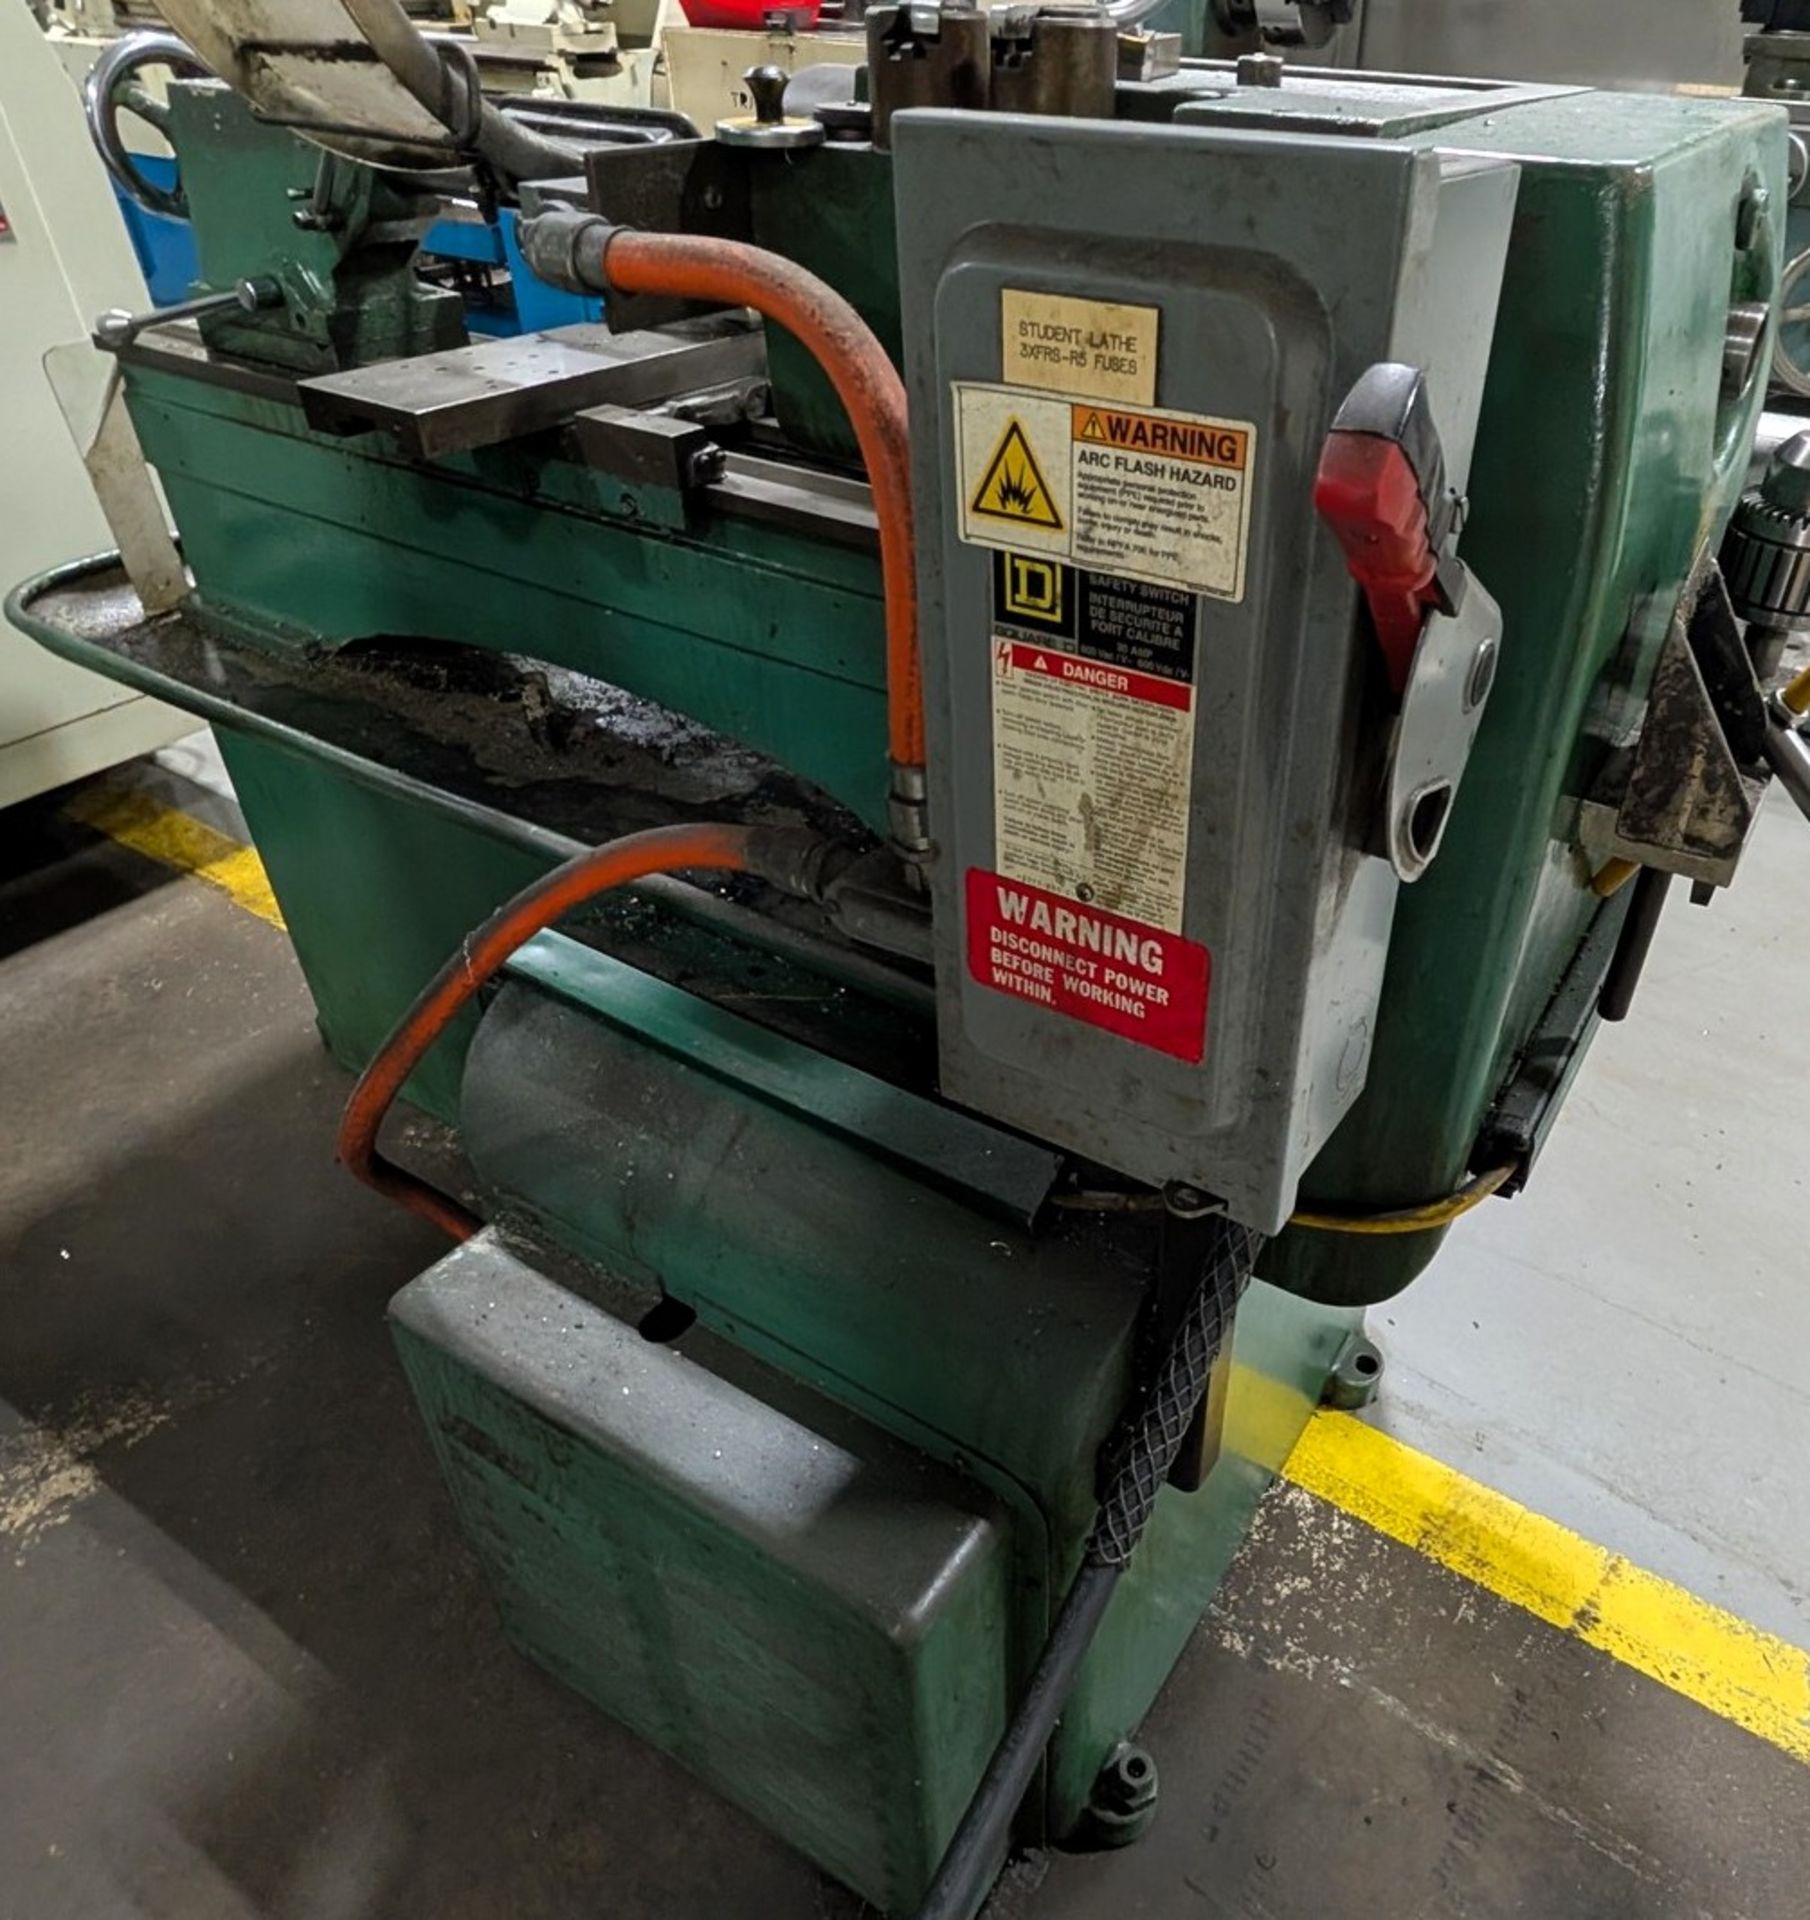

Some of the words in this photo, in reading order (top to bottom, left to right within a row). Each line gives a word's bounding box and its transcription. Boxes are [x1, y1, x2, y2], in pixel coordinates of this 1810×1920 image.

[1018, 320, 1083, 346] STUDENT
[1091, 331, 1138, 354] LATHE
[1094, 354, 1138, 375] FUSES
[1106, 414, 1237, 464] WARNING
[1078, 450, 1110, 469] ARC
[1114, 456, 1165, 480] FLASH
[1169, 463, 1237, 492] HAZARD
[1014, 558, 1053, 609] D
[1088, 574, 1138, 595] SAFETY
[1140, 584, 1190, 606] SWITCH
[1088, 591, 1184, 624] INTERRUPTEUR
[1088, 605, 1106, 619] DE
[1091, 619, 1123, 636] FORT
[1126, 628, 1181, 651] CALIBRE
[1063, 661, 1129, 691] DANGER
[997, 885, 1164, 976] WARNING
[990, 925, 1098, 979] DISCONNECT
[1104, 968, 1169, 1006] POWER
[990, 947, 1055, 985] BEFORE
[1063, 973, 1146, 1019] WORKING
[991, 966, 1057, 1006] WITHIN.
